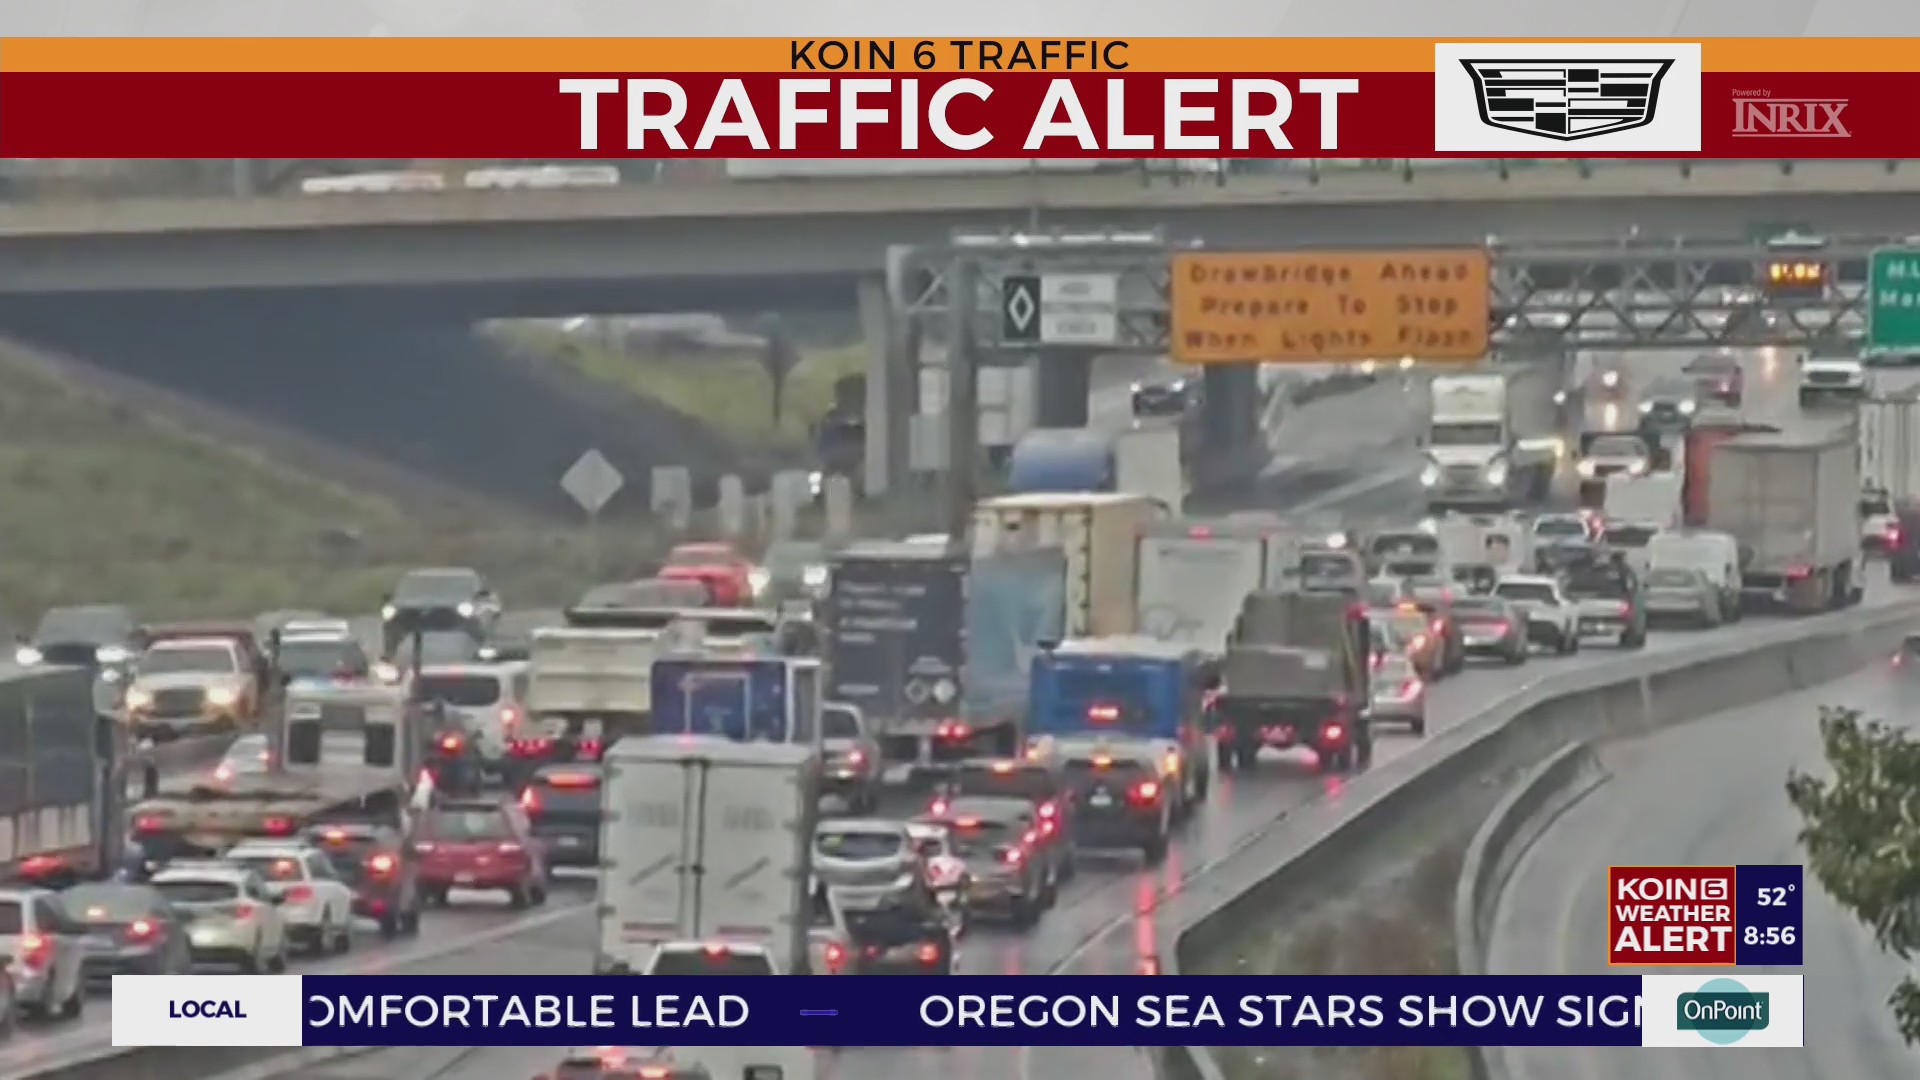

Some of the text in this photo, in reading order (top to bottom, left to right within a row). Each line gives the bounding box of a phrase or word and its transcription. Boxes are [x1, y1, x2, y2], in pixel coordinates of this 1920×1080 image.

[1381, 262, 1469, 282] Ahead
[1201, 296, 1310, 320] Prepare
[1398, 294, 1458, 317] Stop
